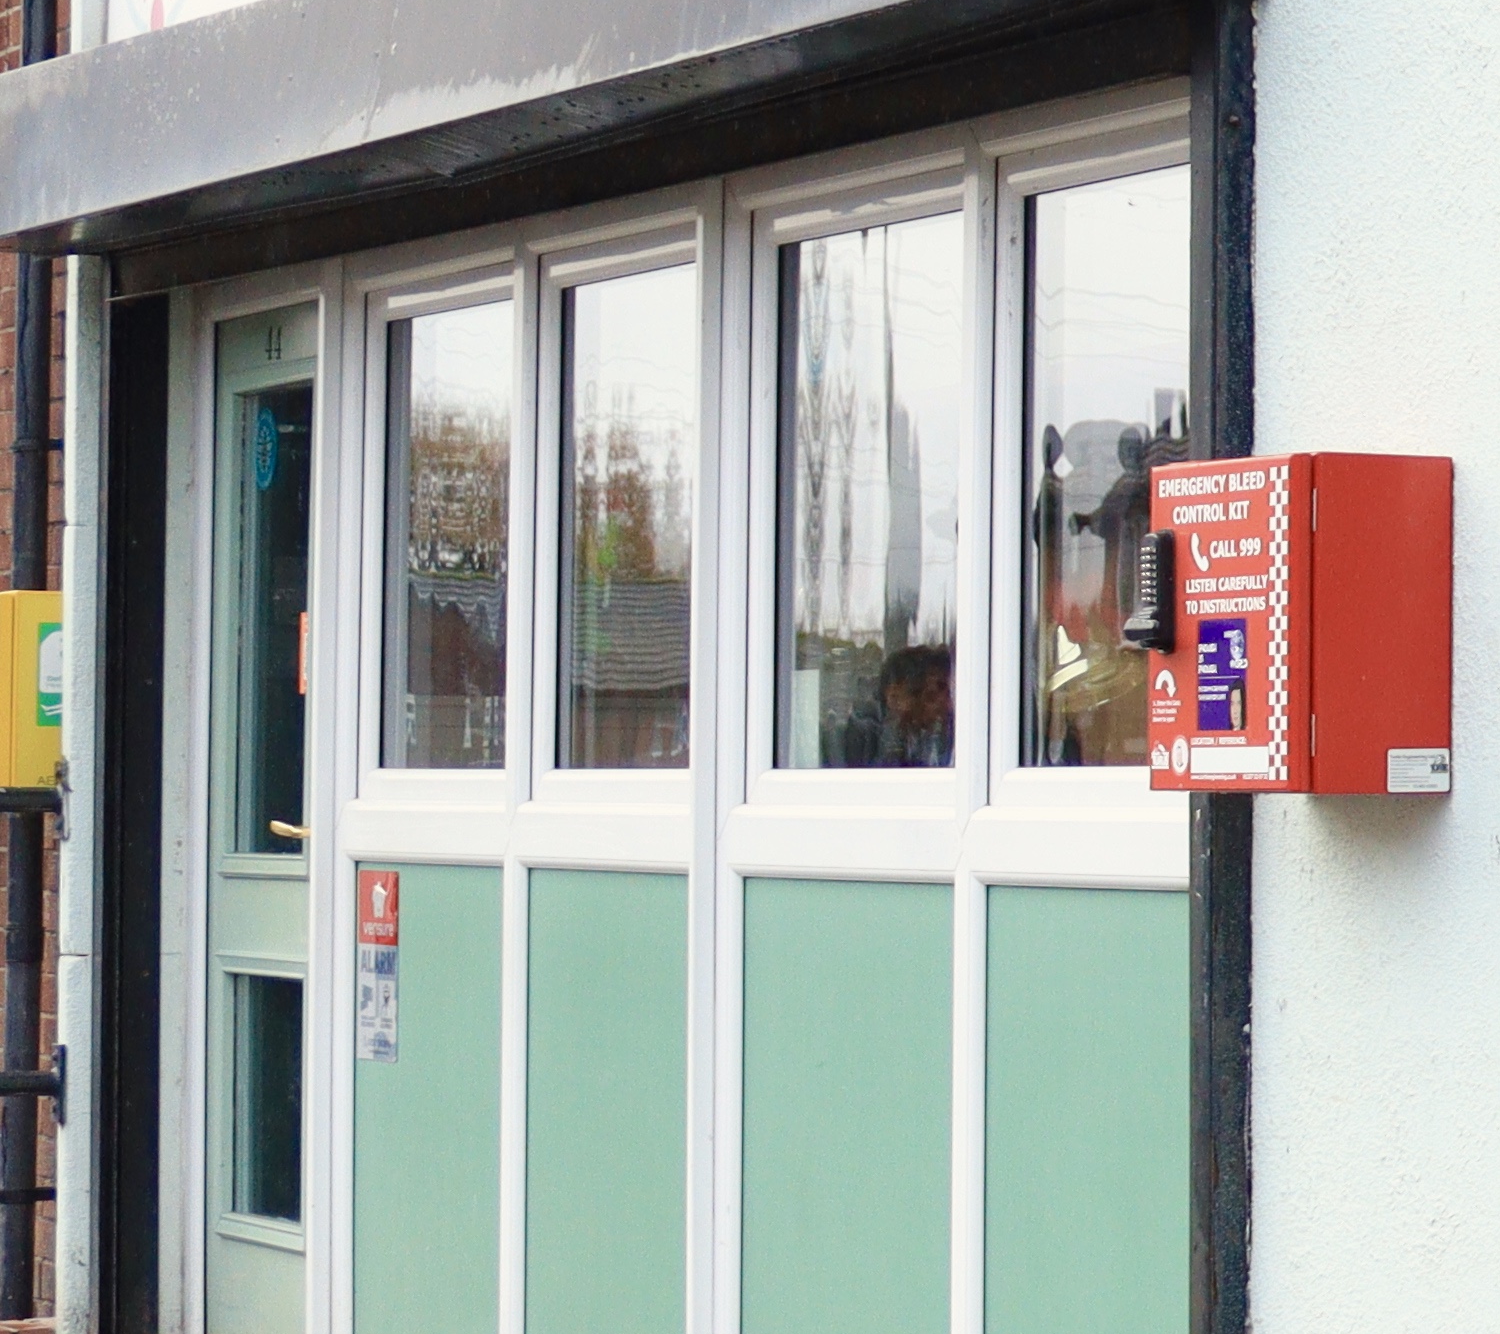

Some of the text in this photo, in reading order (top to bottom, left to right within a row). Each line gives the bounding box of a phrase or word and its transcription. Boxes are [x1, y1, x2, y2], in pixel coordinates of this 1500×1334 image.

[1158, 471, 1266, 498] EMERGENCY BLEED
[1172, 500, 1250, 525] CONTROL KIT
[1209, 537, 1262, 559] CALL 999
[1185, 574, 1268, 593] LISTEN CAREFULLY
[1185, 596, 1267, 615] TO INSTRUCTIONS
